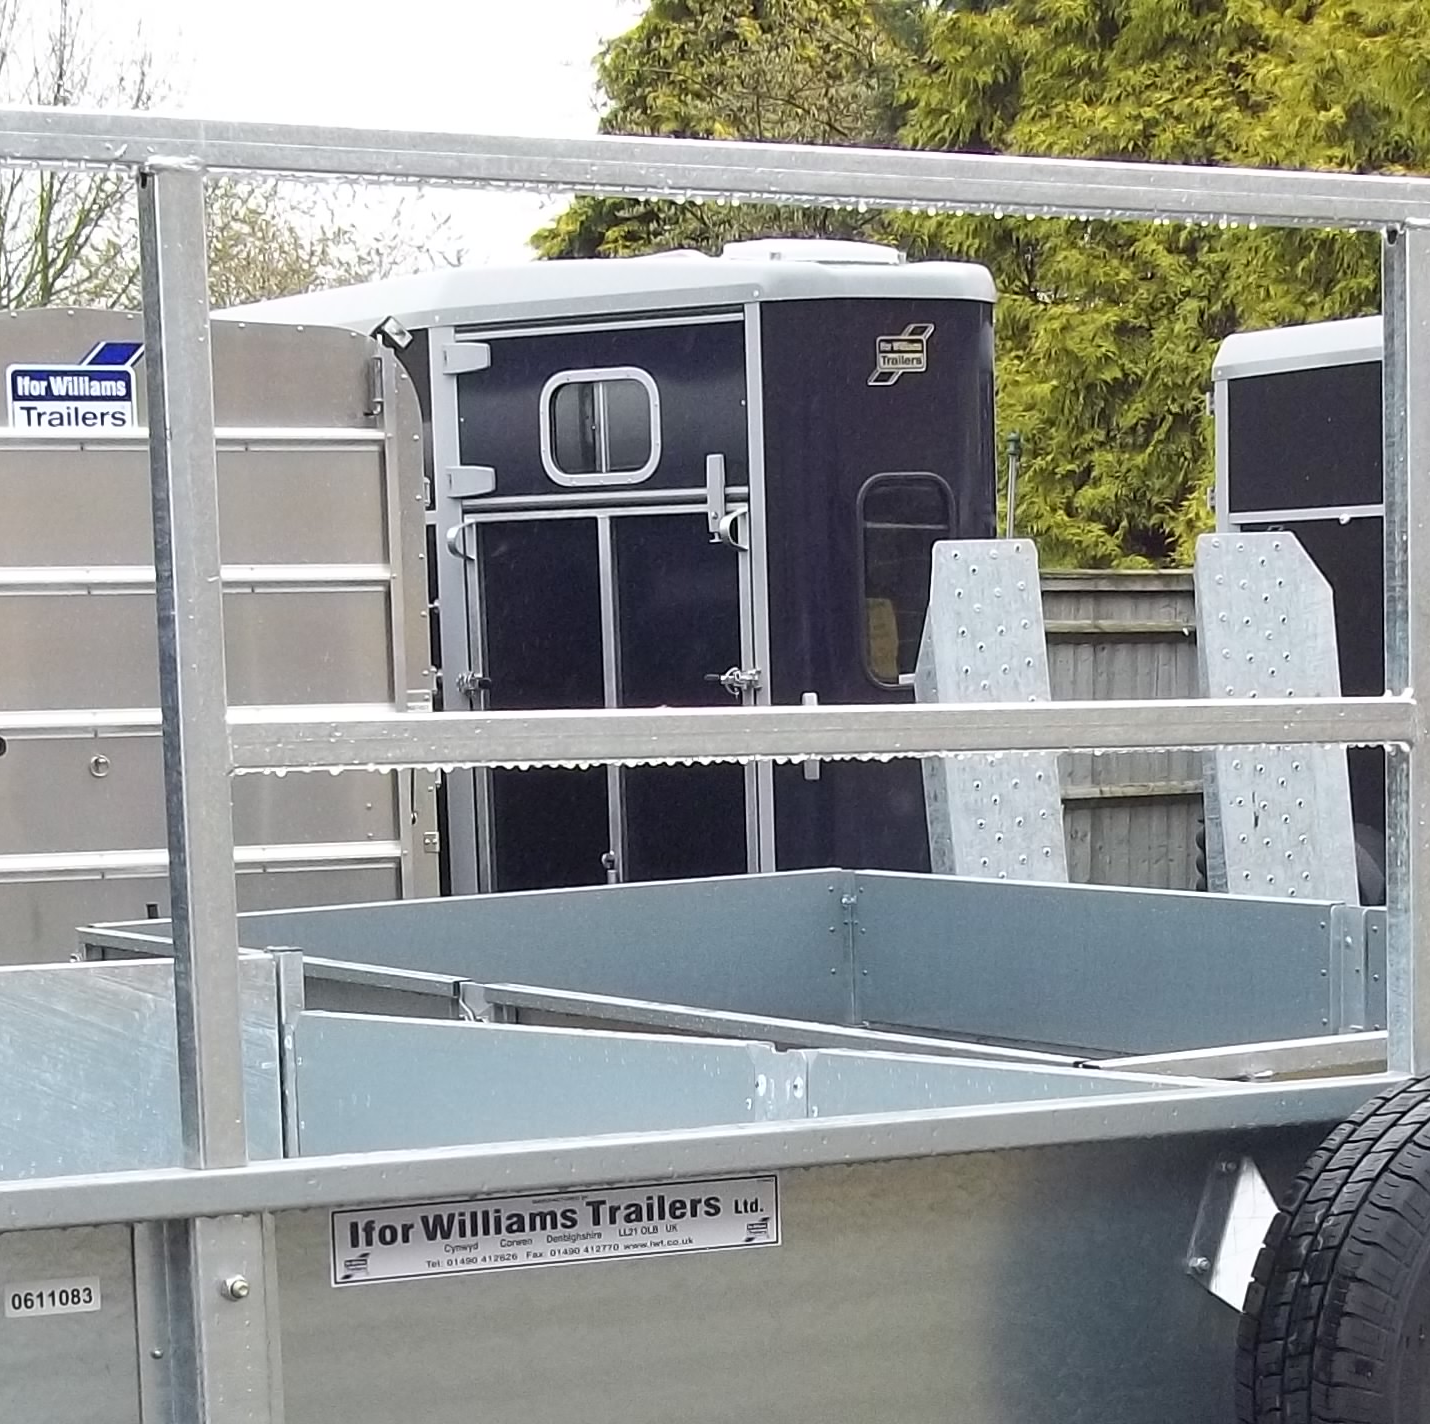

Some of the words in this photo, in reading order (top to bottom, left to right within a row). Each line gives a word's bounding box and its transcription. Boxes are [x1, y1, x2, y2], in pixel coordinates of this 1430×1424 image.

[881, 355, 922, 365] Trailers
[16, 375, 48, 397] Ifor
[49, 375, 127, 397] Williams
[19, 406, 127, 428] Trailers
[349, 1219, 414, 1249] Ifor
[421, 1208, 579, 1241] Williams
[585, 1195, 721, 1227] Trailers
[734, 1198, 764, 1214] Ltd.
[619, 1225, 638, 1237] LL21
[665, 1224, 678, 1233] UK
[446, 1256, 478, 1267] 01490
[550, 1247, 581, 1257] 01490
[583, 1243, 620, 1254] 412770
[11, 1287, 93, 1310] 0611083
